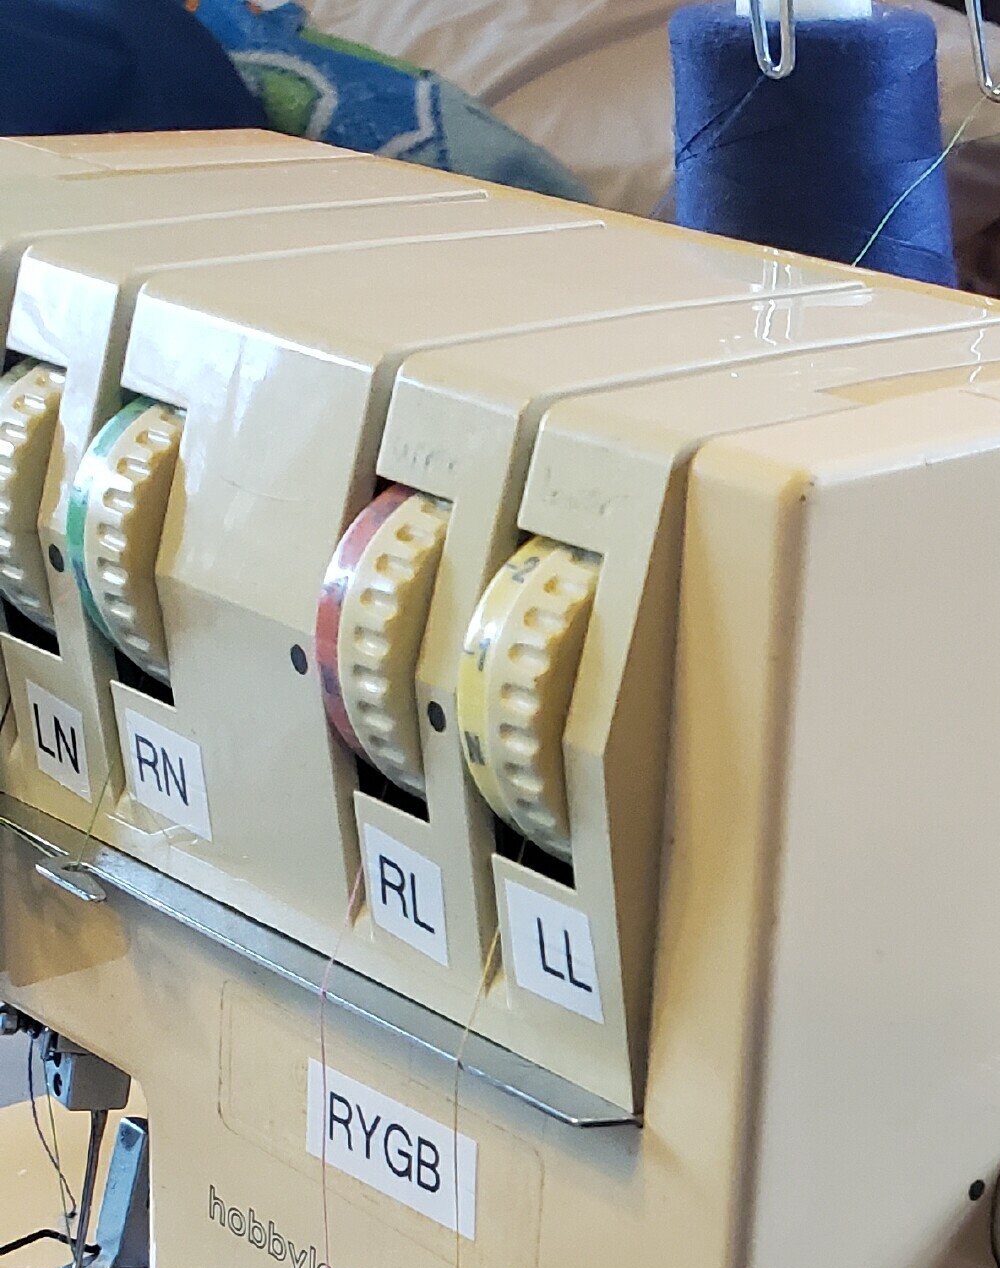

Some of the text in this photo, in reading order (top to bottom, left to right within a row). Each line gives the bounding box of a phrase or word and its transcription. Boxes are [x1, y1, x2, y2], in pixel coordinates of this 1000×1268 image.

[33, 703, 80, 774] LN
[135, 733, 189, 806] RN
[379, 854, 435, 934] RL
[537, 917, 593, 992] LL
[329, 1091, 441, 1193] RYGB
